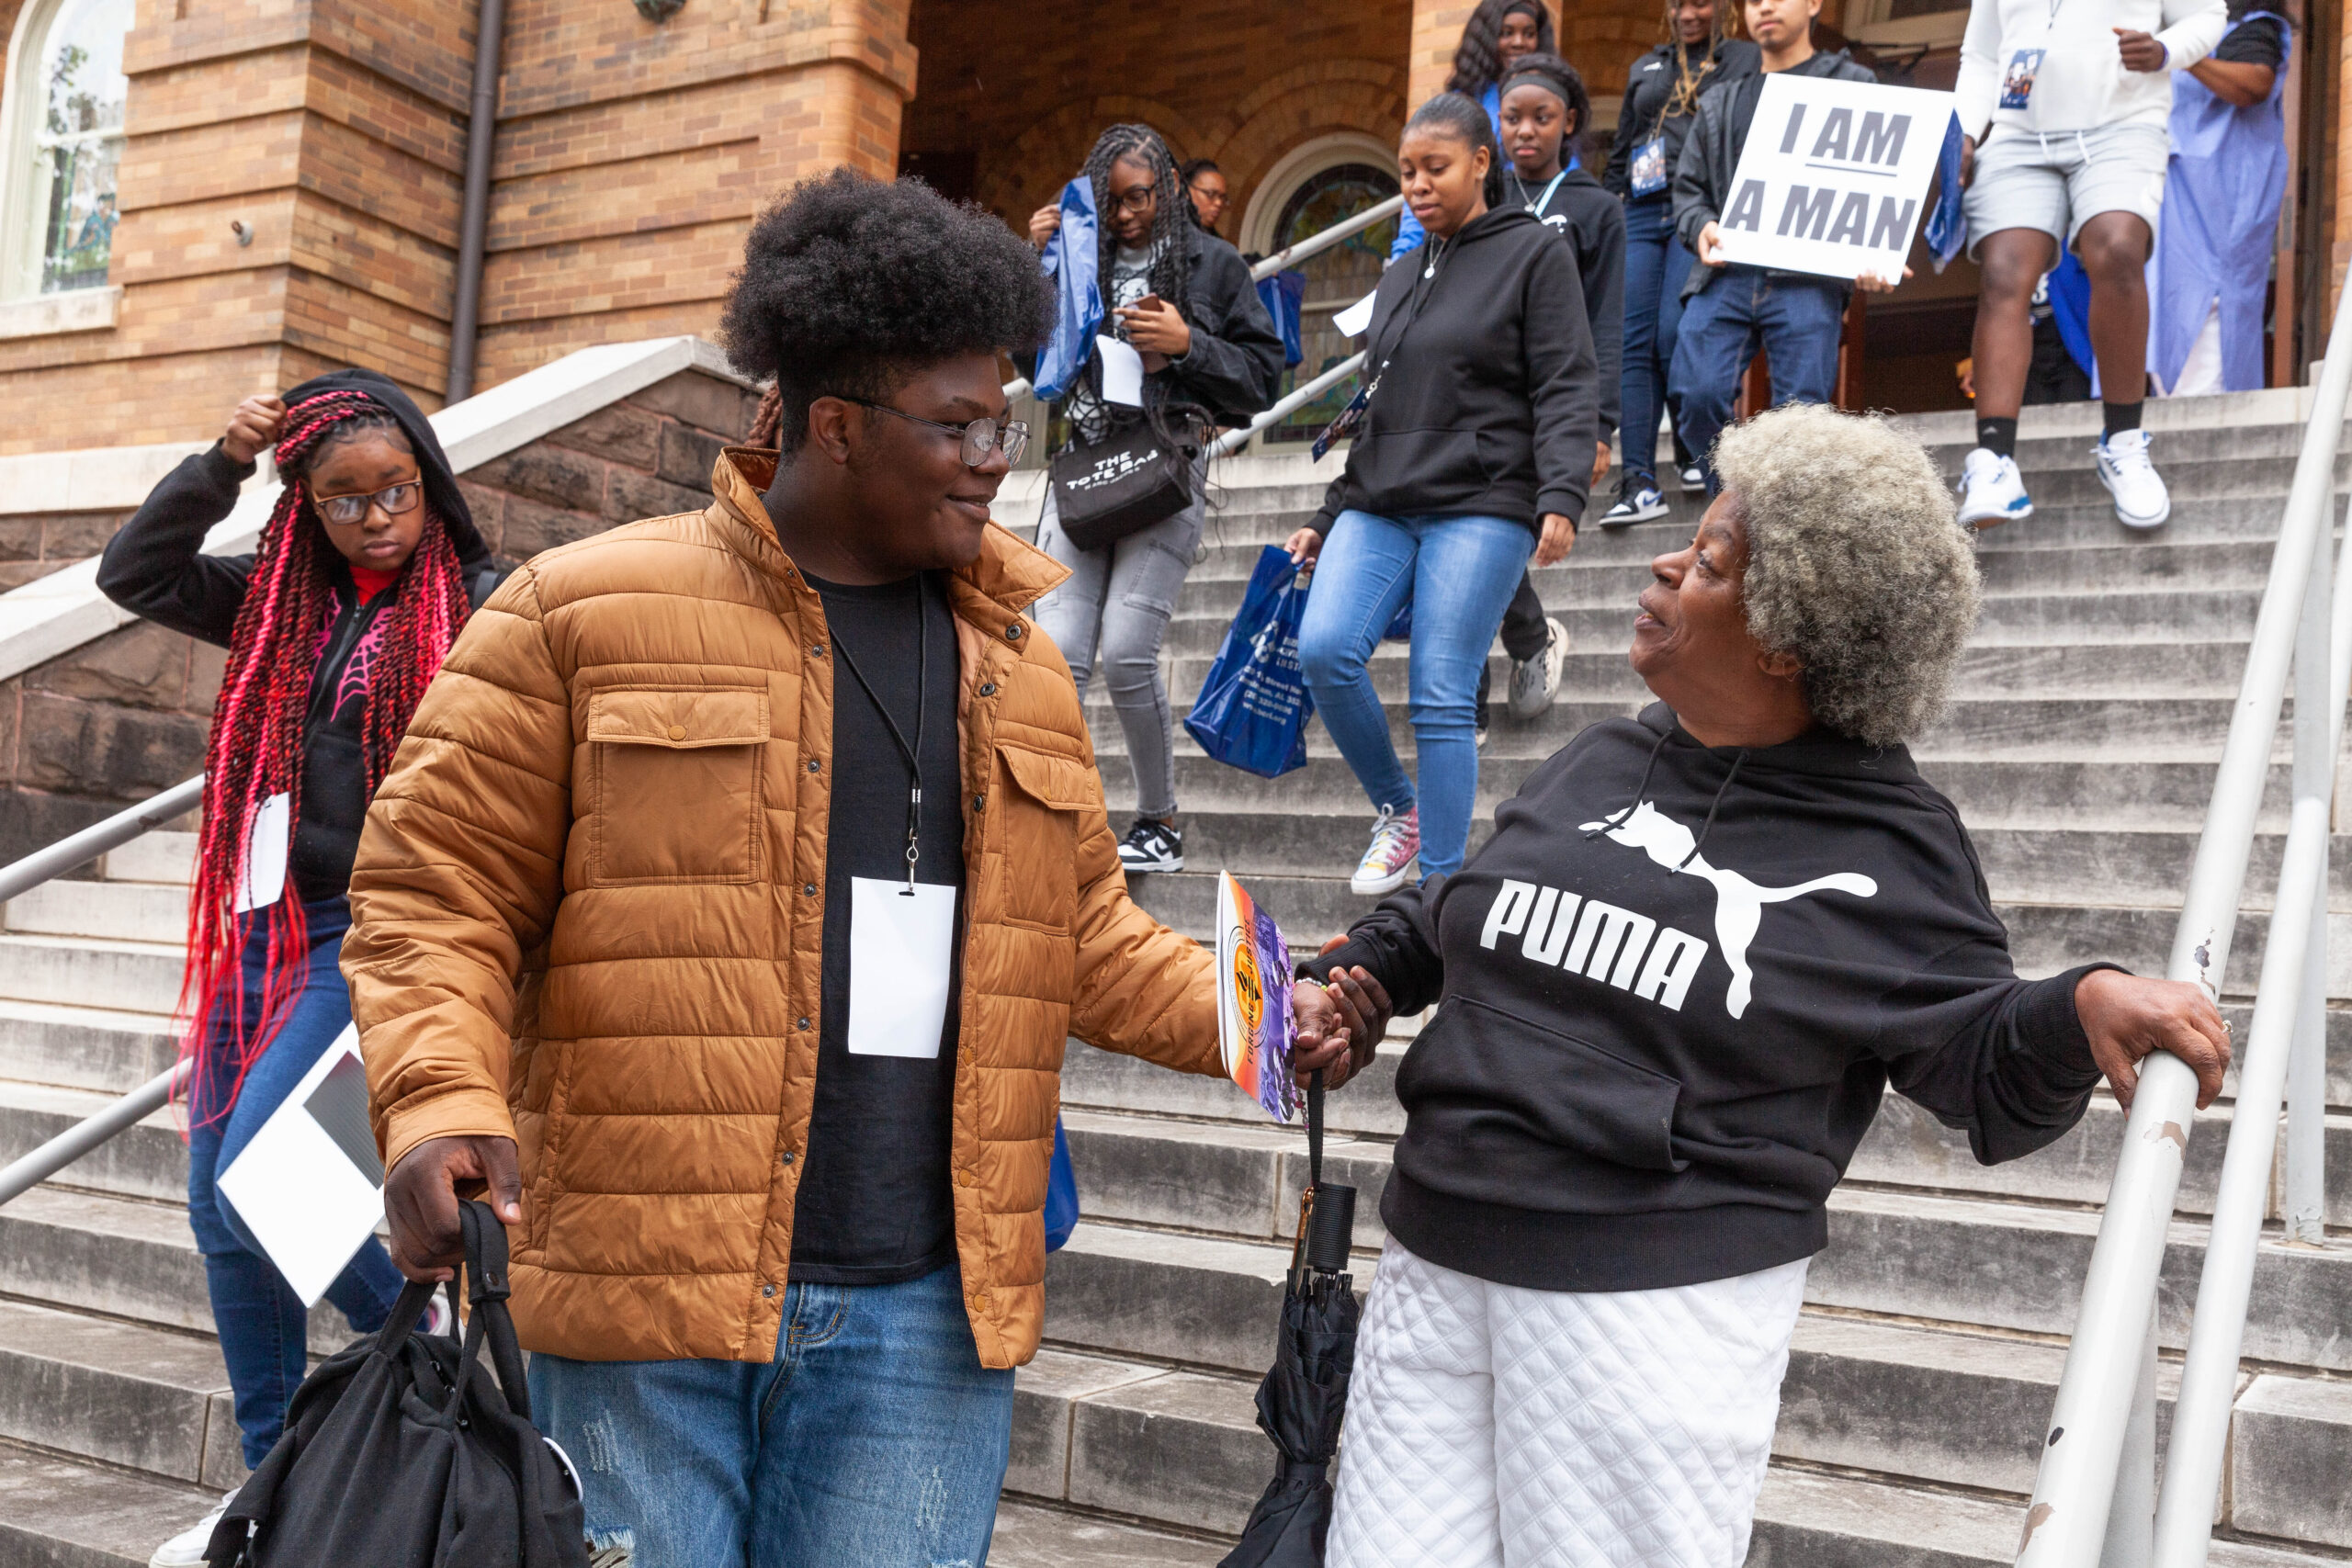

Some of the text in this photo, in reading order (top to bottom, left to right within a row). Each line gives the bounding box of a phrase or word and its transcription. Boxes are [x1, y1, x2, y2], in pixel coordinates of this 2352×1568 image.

[1779, 103, 1913, 167] I AM
[1723, 178, 1917, 252] A MAN
[1066, 468, 1115, 490] TOTE
[1094, 450, 1132, 471] THE
[1479, 878, 1710, 1012] PUMA
[1243, 915, 1255, 1065] FORGING JUSTICE
